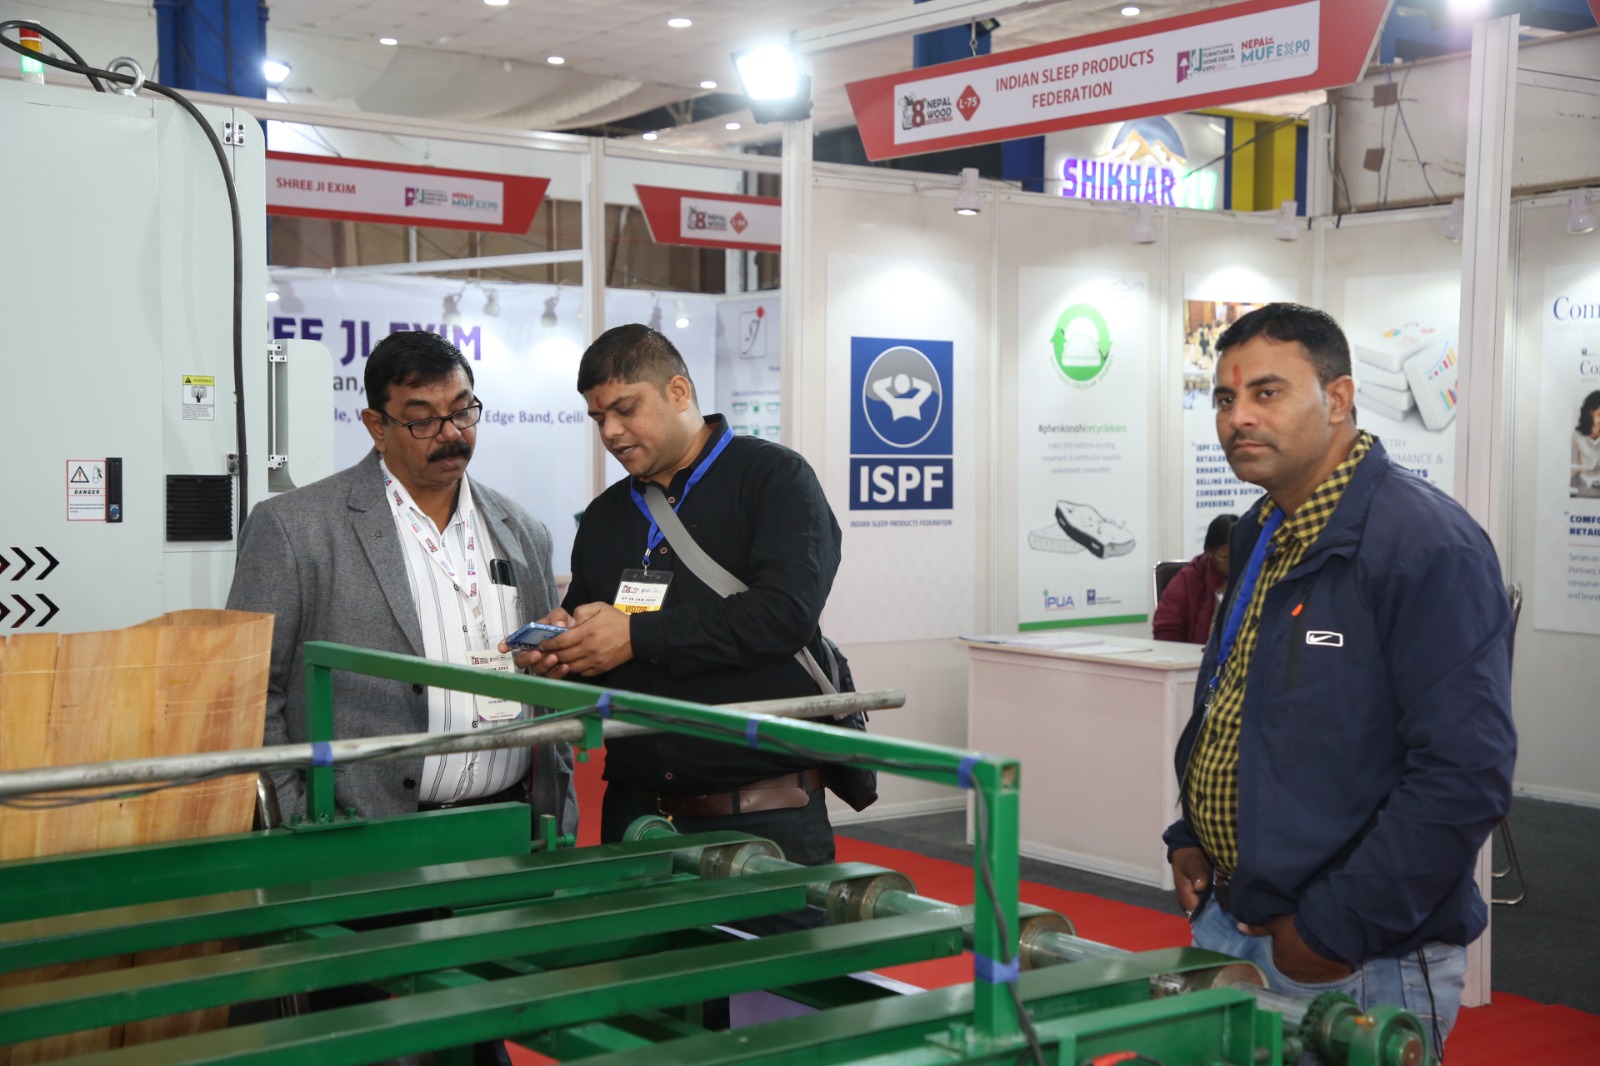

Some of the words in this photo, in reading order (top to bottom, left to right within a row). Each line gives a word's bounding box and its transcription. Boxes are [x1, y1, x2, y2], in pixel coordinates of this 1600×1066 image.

[1203, 50, 1229, 58] FURNITURE
[1218, 55, 1235, 63] DECOR
[1241, 46, 1274, 63] MUF
[1276, 39, 1310, 57] EXPO
[996, 72, 1039, 92] INDIAN
[1042, 64, 1079, 84] SLEEP
[1082, 49, 1154, 76] PRODUCTS
[1032, 81, 1112, 108] FEDERATION
[912, 100, 925, 128] 8
[927, 97, 952, 109] NEPAL
[927, 108, 952, 119] WOOD
[276, 178, 313, 191] SHREE
[316, 182, 325, 192] JI
[328, 182, 356, 194] EXIM
[1063, 158, 1176, 207] SHIKHAR
[264, 317, 324, 340] EE
[340, 319, 370, 367] JI
[1580, 359, 1600, 376] Co
[485, 410, 515, 426] Edge
[519, 410, 554, 426] Band,
[860, 465, 944, 503] ISPF
[1196, 500, 1235, 508] EXPERIENCE
[850, 520, 870, 528] INDIAN
[872, 520, 888, 528] SLEEP
[890, 519, 918, 527] PRODUCTS
